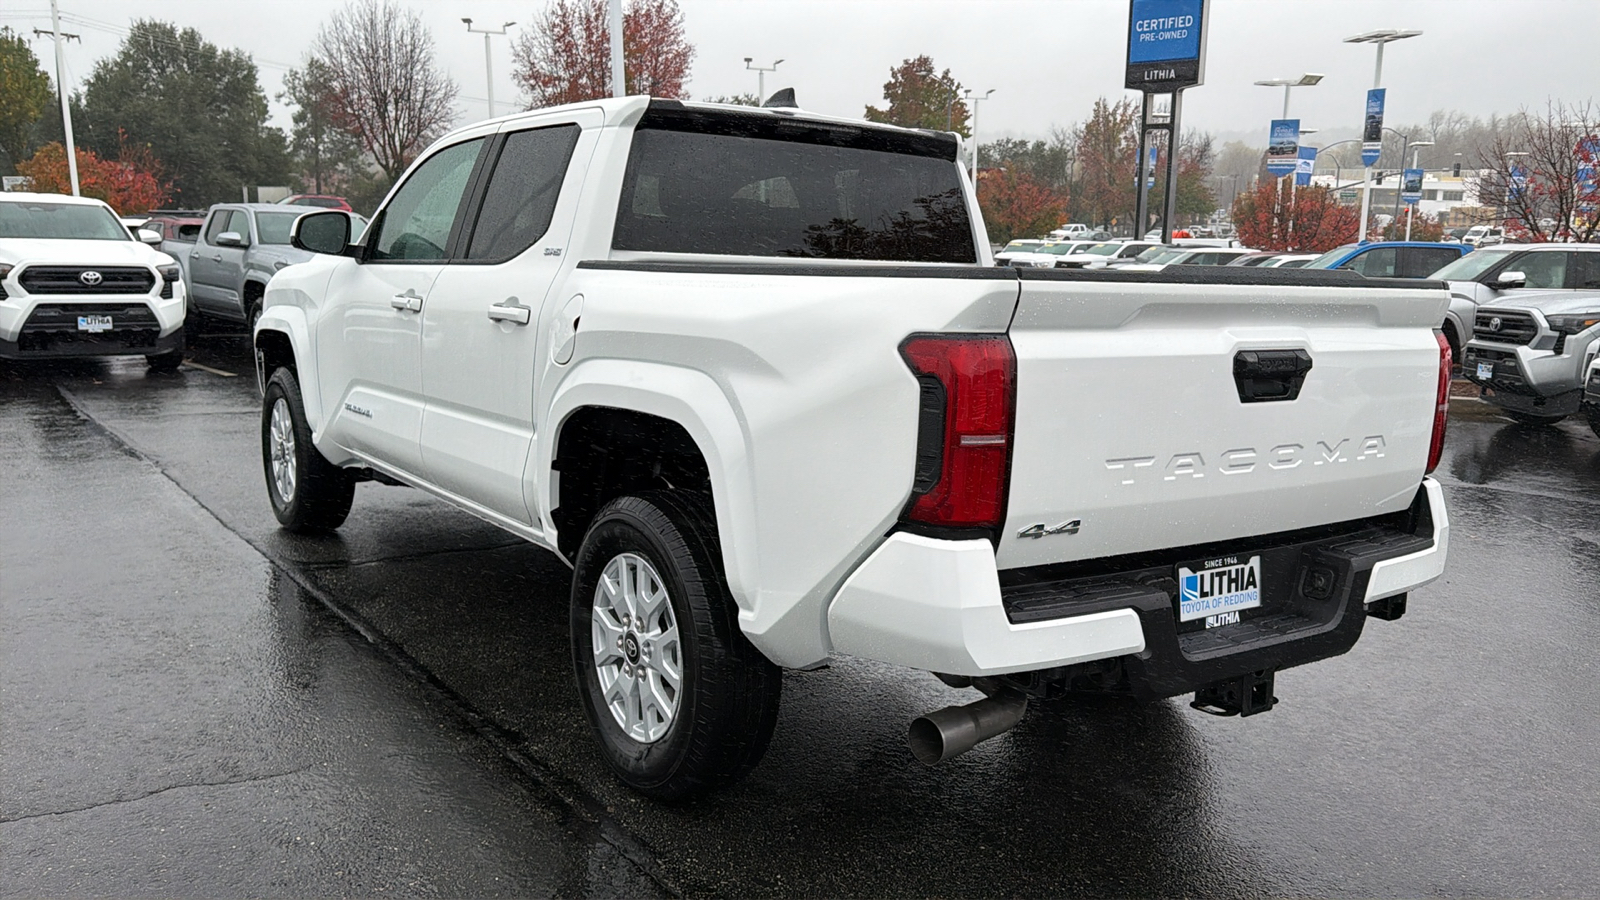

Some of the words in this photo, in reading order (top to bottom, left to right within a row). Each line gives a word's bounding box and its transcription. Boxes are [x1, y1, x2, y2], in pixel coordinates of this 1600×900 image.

[1136, 15, 1193, 32] CERTIFIED
[1140, 29, 1188, 42] PRE-OWNED
[1144, 69, 1176, 80] LITHIA
[1260, 358, 1295, 369] TOYOTA
[1105, 434, 1386, 484] TACOMA
[1204, 558, 1222, 569] SINCE
[1224, 556, 1238, 566] 1946
[1199, 565, 1257, 599] LITHIA
[1182, 602, 1210, 614] TOYOTA
[1212, 598, 1222, 609] OF
[1225, 591, 1258, 606] REDDING
[1213, 611, 1240, 627] LITHIA
